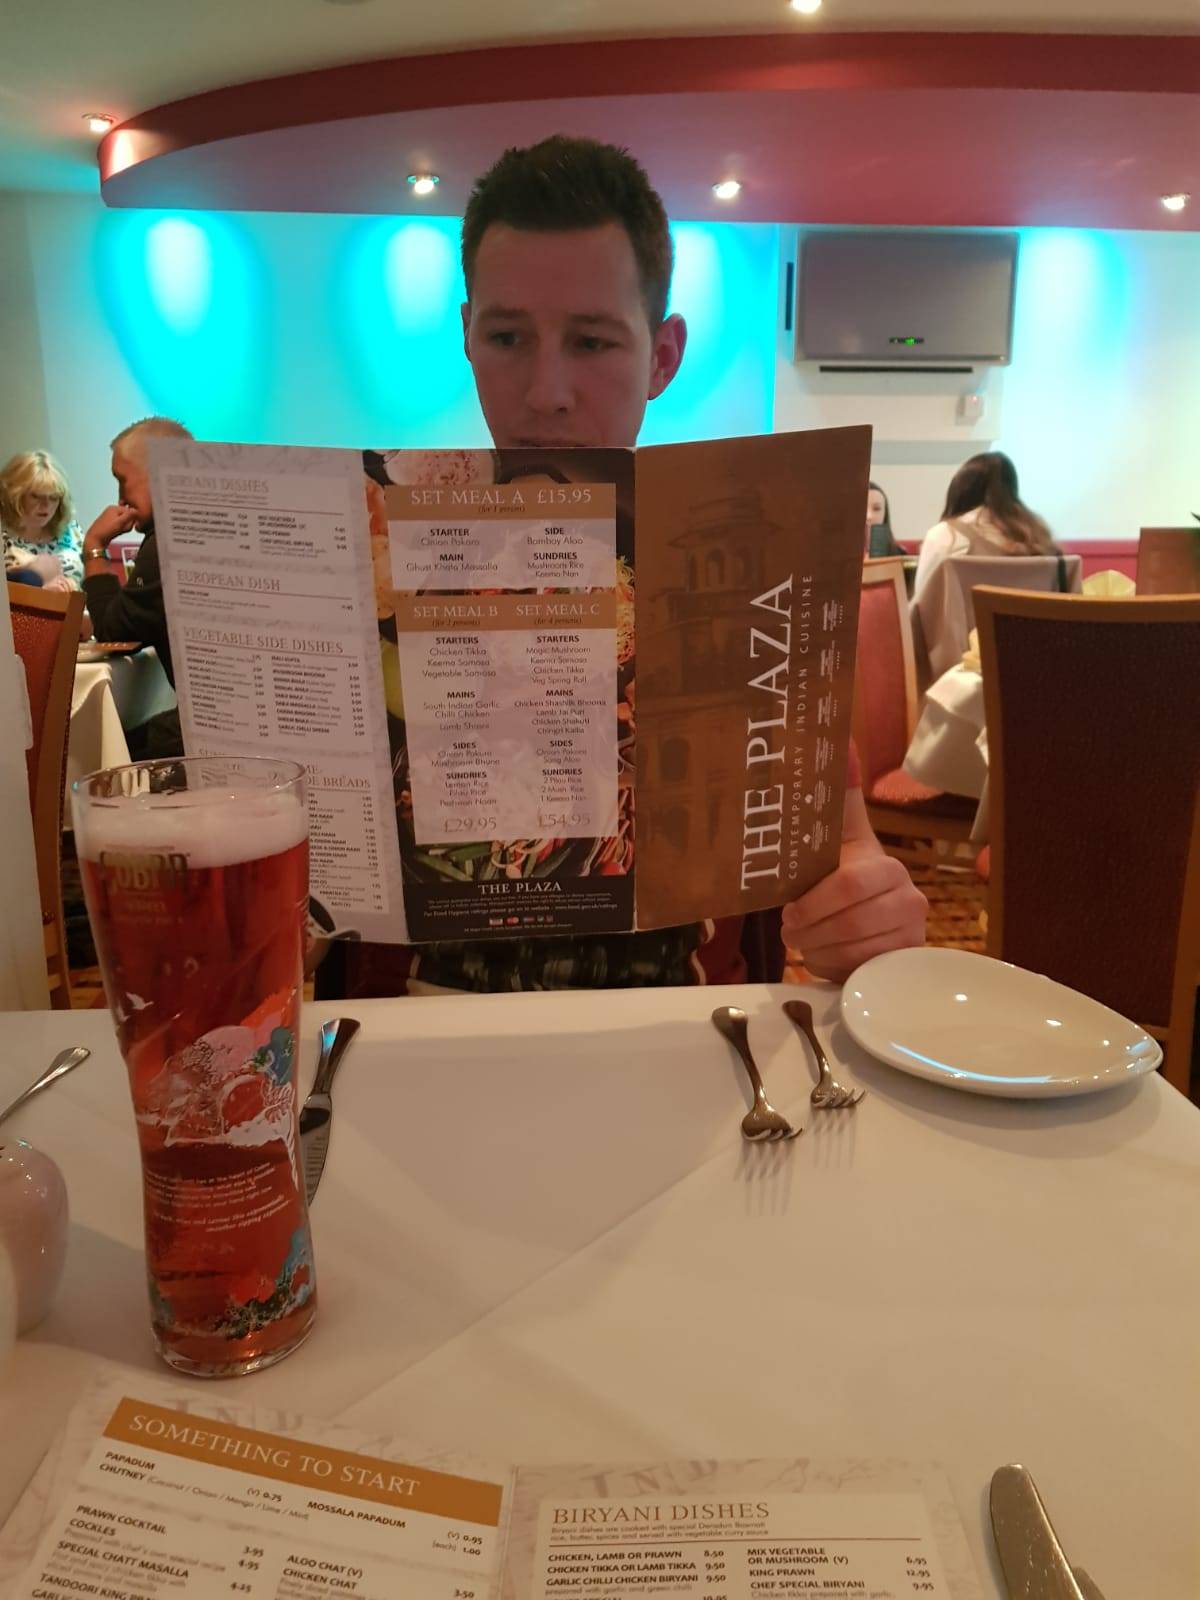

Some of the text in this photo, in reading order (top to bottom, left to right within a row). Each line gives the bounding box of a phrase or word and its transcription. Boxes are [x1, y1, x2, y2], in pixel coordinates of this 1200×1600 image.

[411, 488, 592, 506] SET MEAL A £15.95
[430, 528, 470, 537] STARTER
[544, 528, 564, 536] SIDE
[527, 536, 584, 547] Bombay Aloo
[439, 553, 464, 561] MAIN
[533, 552, 578, 561] SUNDRIES
[527, 561, 568, 570] Mushroom
[177, 570, 280, 592] EUROPEAN DISH
[413, 605, 498, 618] SET MEAL B
[515, 604, 600, 617] SET MEAL C
[184, 627, 344, 655] VEGETABLE SIDE DISHES
[435, 636, 478, 645] STARTERS
[536, 635, 580, 643] STARTERS
[429, 647, 488, 656] Chicken Tikka
[457, 658, 490, 667] Samosa
[421, 669, 497, 680] Vegetable Samosa
[533, 666, 584, 675] Chicken Tikka
[446, 690, 476, 699] MAINS
[545, 689, 574, 697] MAINS
[457, 710, 490, 718] Chicken
[740, 573, 793, 890] THE PLAZA
[788, 575, 812, 880] CONTEMPORARY INDIAN CUISINE
[452, 741, 477, 750] SIDES
[549, 739, 574, 747] SIDES
[446, 771, 487, 780] SUNDRIES
[541, 768, 584, 776] SUNDRIES
[323, 777, 371, 789] BREADS
[444, 816, 497, 833] £29.95
[537, 813, 592, 829] £54.95
[478, 881, 563, 895] THE PLAZA
[105, 1451, 156, 1473] PAPADUM
[129, 1414, 422, 1498] SOMETHING TO START
[99, 1463, 148, 1483] CHUTNEY
[76, 1504, 168, 1535] PRAWN COCKTAIL
[307, 1501, 407, 1530] MOSSALA PAPADUM
[553, 1503, 770, 1525] BIRYANI DISHES
[69, 1517, 117, 1537] COCKLES
[652, 1523, 667, 1531] with
[669, 1523, 696, 1532] special
[463, 1534, 483, 1547] 0.95
[622, 1532, 637, 1540] and
[639, 1532, 665, 1540] served
[666, 1531, 682, 1539] with
[684, 1530, 723, 1539] vegetable
[463, 1547, 481, 1557] 1.00
[548, 1549, 725, 1564] CHICKEN, LAMB OR PRAWN 8.50
[747, 1547, 826, 1557] MIX VEGETABLE
[57, 1540, 100, 1560] SPECIAL
[102, 1550, 136, 1569] CHATT
[137, 1558, 190, 1580] MASALLA
[747, 1556, 763, 1565] OR
[765, 1555, 829, 1565] MUSHROOM
[833, 1555, 849, 1567] (V)
[287, 1554, 364, 1580] ALOO CHAT (V)
[547, 1561, 725, 1575] CHICKEN TIKKA OR LAMB TIKKA 9.50
[750, 1568, 775, 1578] KING
[776, 1567, 815, 1577] PRAWN
[39, 1572, 101, 1597] TANDOORI
[101, 1585, 128, 1600] KING
[282, 1568, 329, 1586] CHICKEN
[329, 1576, 359, 1592] CHAT
[546, 1573, 727, 1588] GARLIC CHILLI CHICKEN BIRYANI 9.50
[750, 1580, 777, 1590] CHEF
[778, 1580, 821, 1590] SPECIAL
[823, 1579, 866, 1589] BIRYANI
